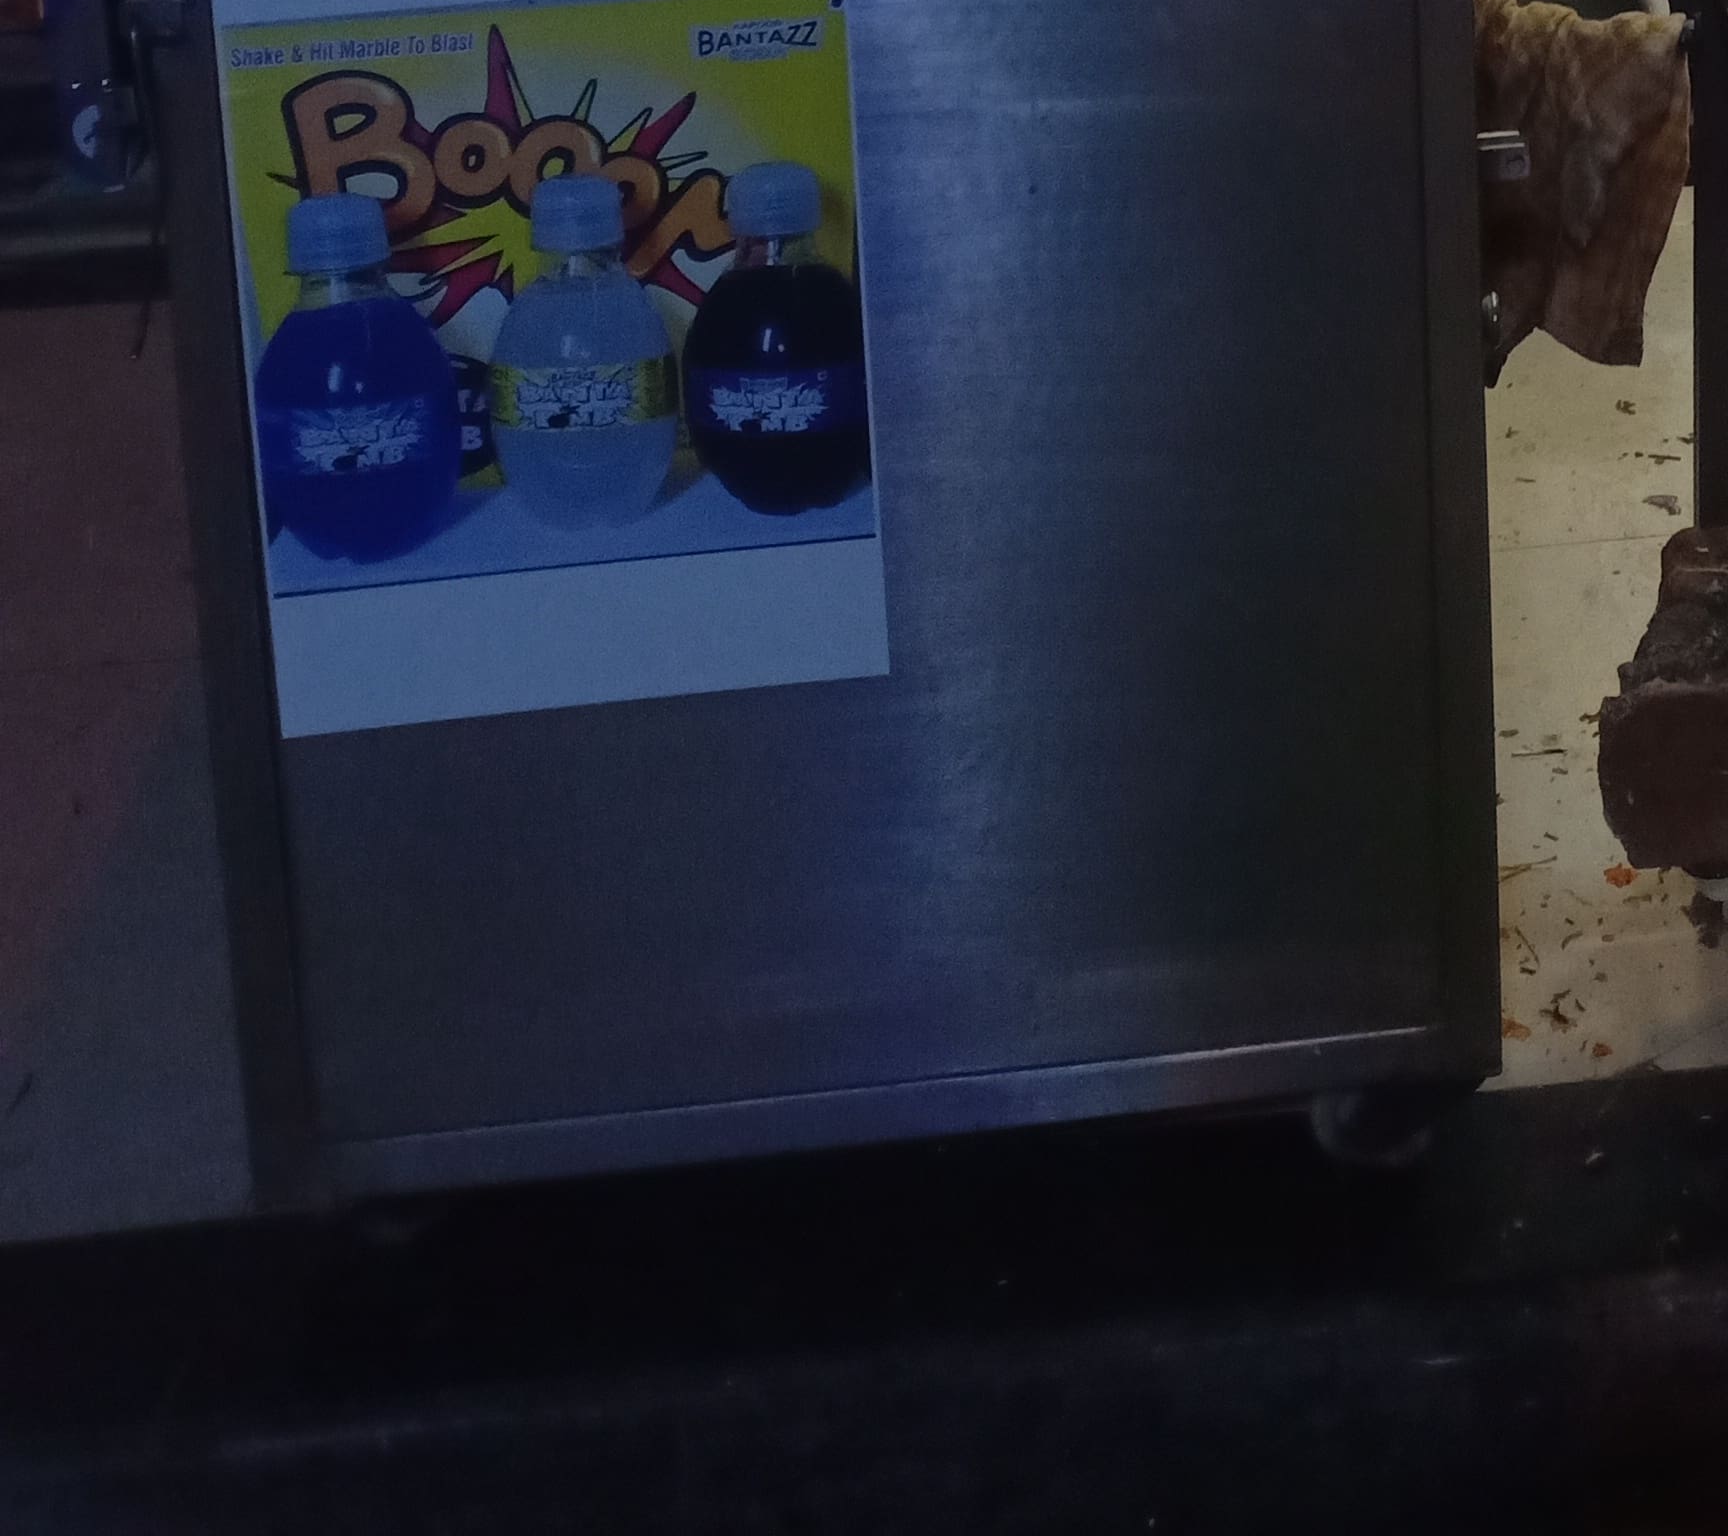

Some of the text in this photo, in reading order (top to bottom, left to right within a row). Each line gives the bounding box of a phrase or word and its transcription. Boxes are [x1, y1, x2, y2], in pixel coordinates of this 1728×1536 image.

[231, 46, 285, 68] Shake
[292, 44, 303, 63] &
[310, 42, 334, 62] Hit
[339, 37, 400, 60] Marble
[407, 35, 426, 55] To
